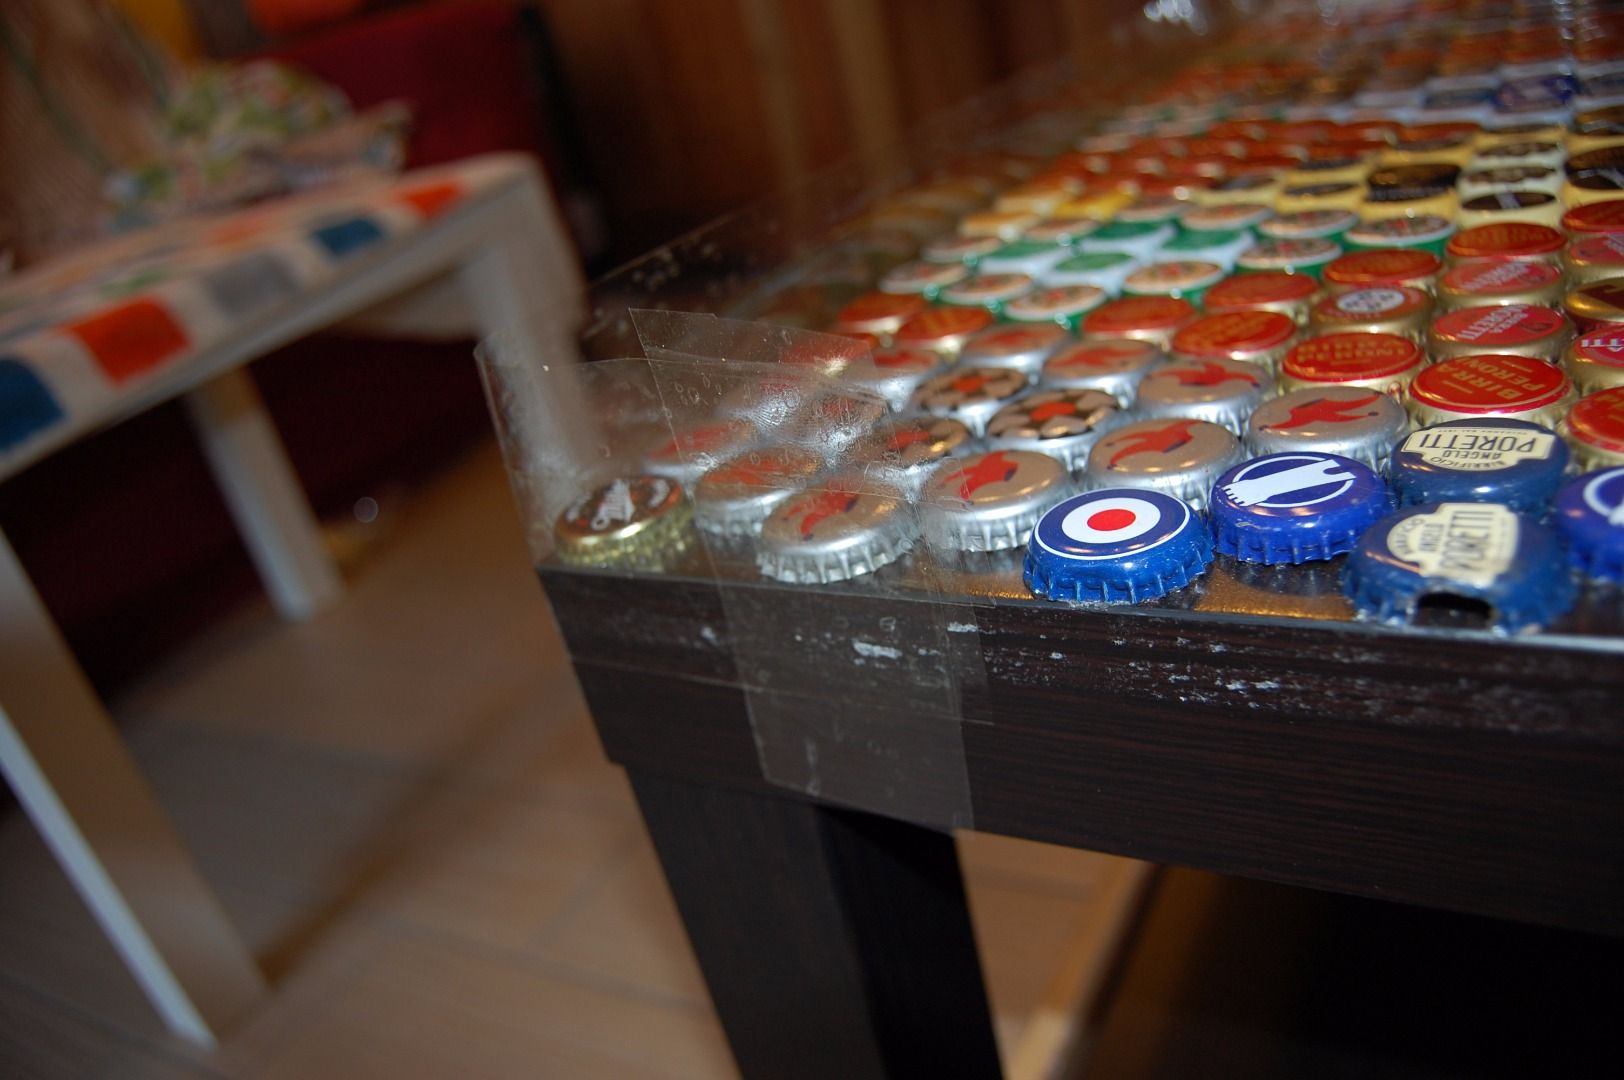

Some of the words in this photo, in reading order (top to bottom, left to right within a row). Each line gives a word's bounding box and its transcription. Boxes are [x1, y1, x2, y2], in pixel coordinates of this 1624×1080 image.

[1437, 363, 1523, 400] BIRRA
[1455, 356, 1547, 391] PERONI
[1419, 433, 1537, 453] PORETTI
[1442, 450, 1502, 460] ANGELO
[1439, 510, 1496, 571] PORETTI
